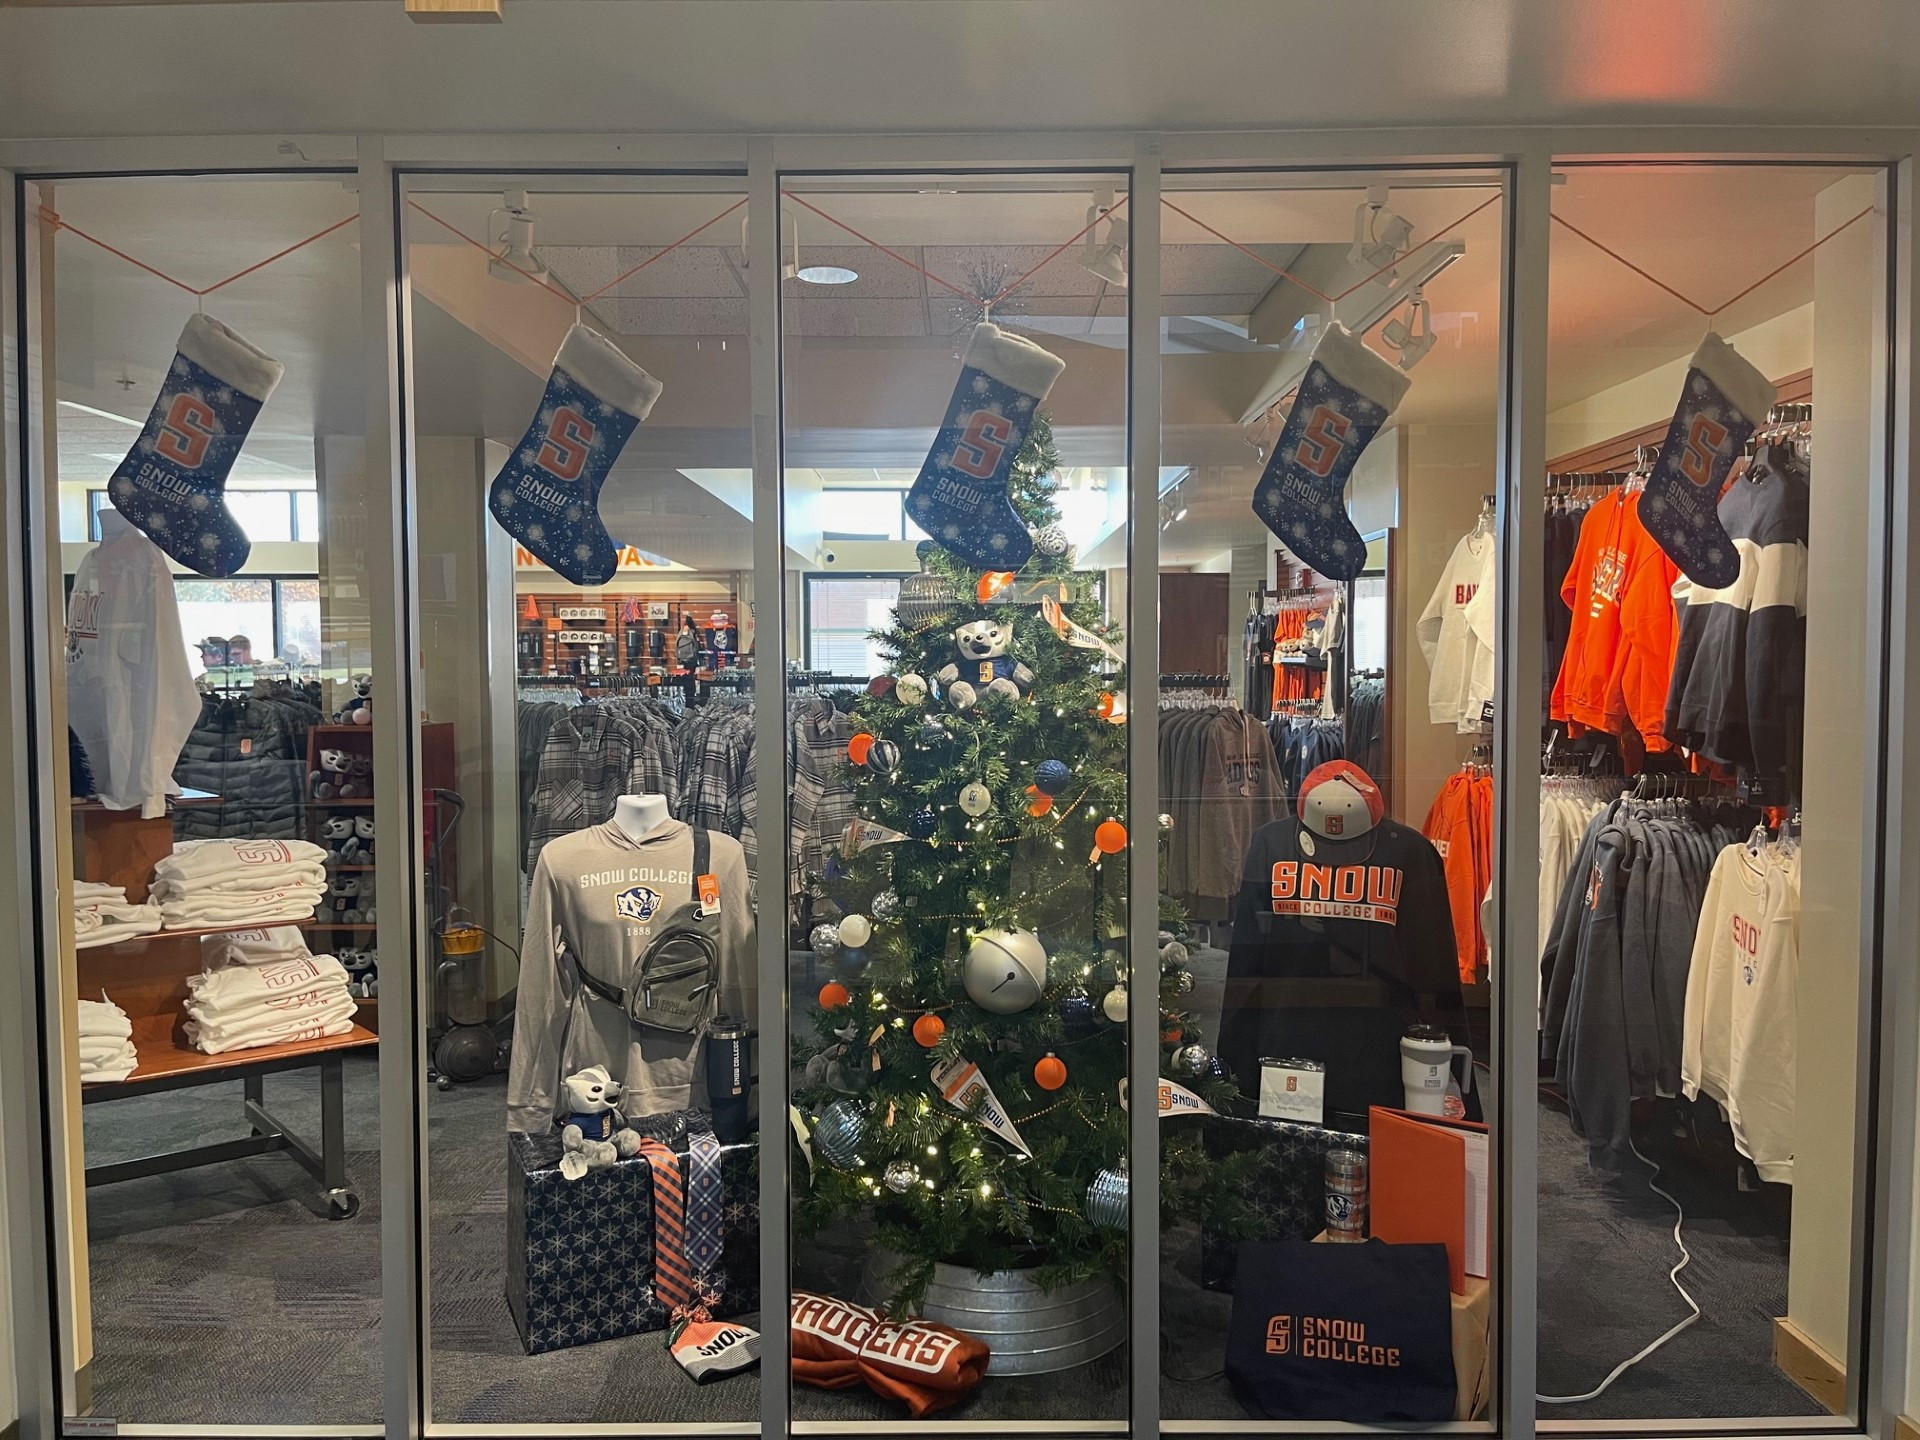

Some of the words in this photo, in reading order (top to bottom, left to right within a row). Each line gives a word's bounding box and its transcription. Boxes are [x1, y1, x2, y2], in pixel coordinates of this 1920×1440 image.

[154, 393, 215, 469] S
[535, 406, 596, 482] S
[949, 409, 1012, 479] S
[1295, 404, 1352, 478] S
[1680, 412, 1728, 487] S
[135, 474, 185, 504] COLLEGE
[140, 462, 192, 496] SNOW
[520, 474, 568, 506] SNOW
[936, 477, 983, 505] SNOW
[1284, 472, 1321, 505] SNOW
[515, 485, 562, 515] COLLEGE
[931, 489, 977, 514] COLLEGE
[1668, 480, 1697, 514] SNOW
[863, 831, 883, 841] SNOW
[1325, 815, 1344, 835] S
[580, 868, 624, 889] SNOW
[1271, 861, 1403, 909] SNOW
[1303, 902, 1372, 919] COLLEGE
[626, 926, 651, 937] 1888
[1733, 914, 1762, 956] SNO
[733, 1067, 741, 1086] SNOW
[1159, 1086, 1172, 1111] S
[1172, 1093, 1199, 1109] SNOW
[1266, 1315, 1291, 1354] S
[1303, 1316, 1365, 1343] SNOW
[1303, 1337, 1400, 1367] COLLEGE
